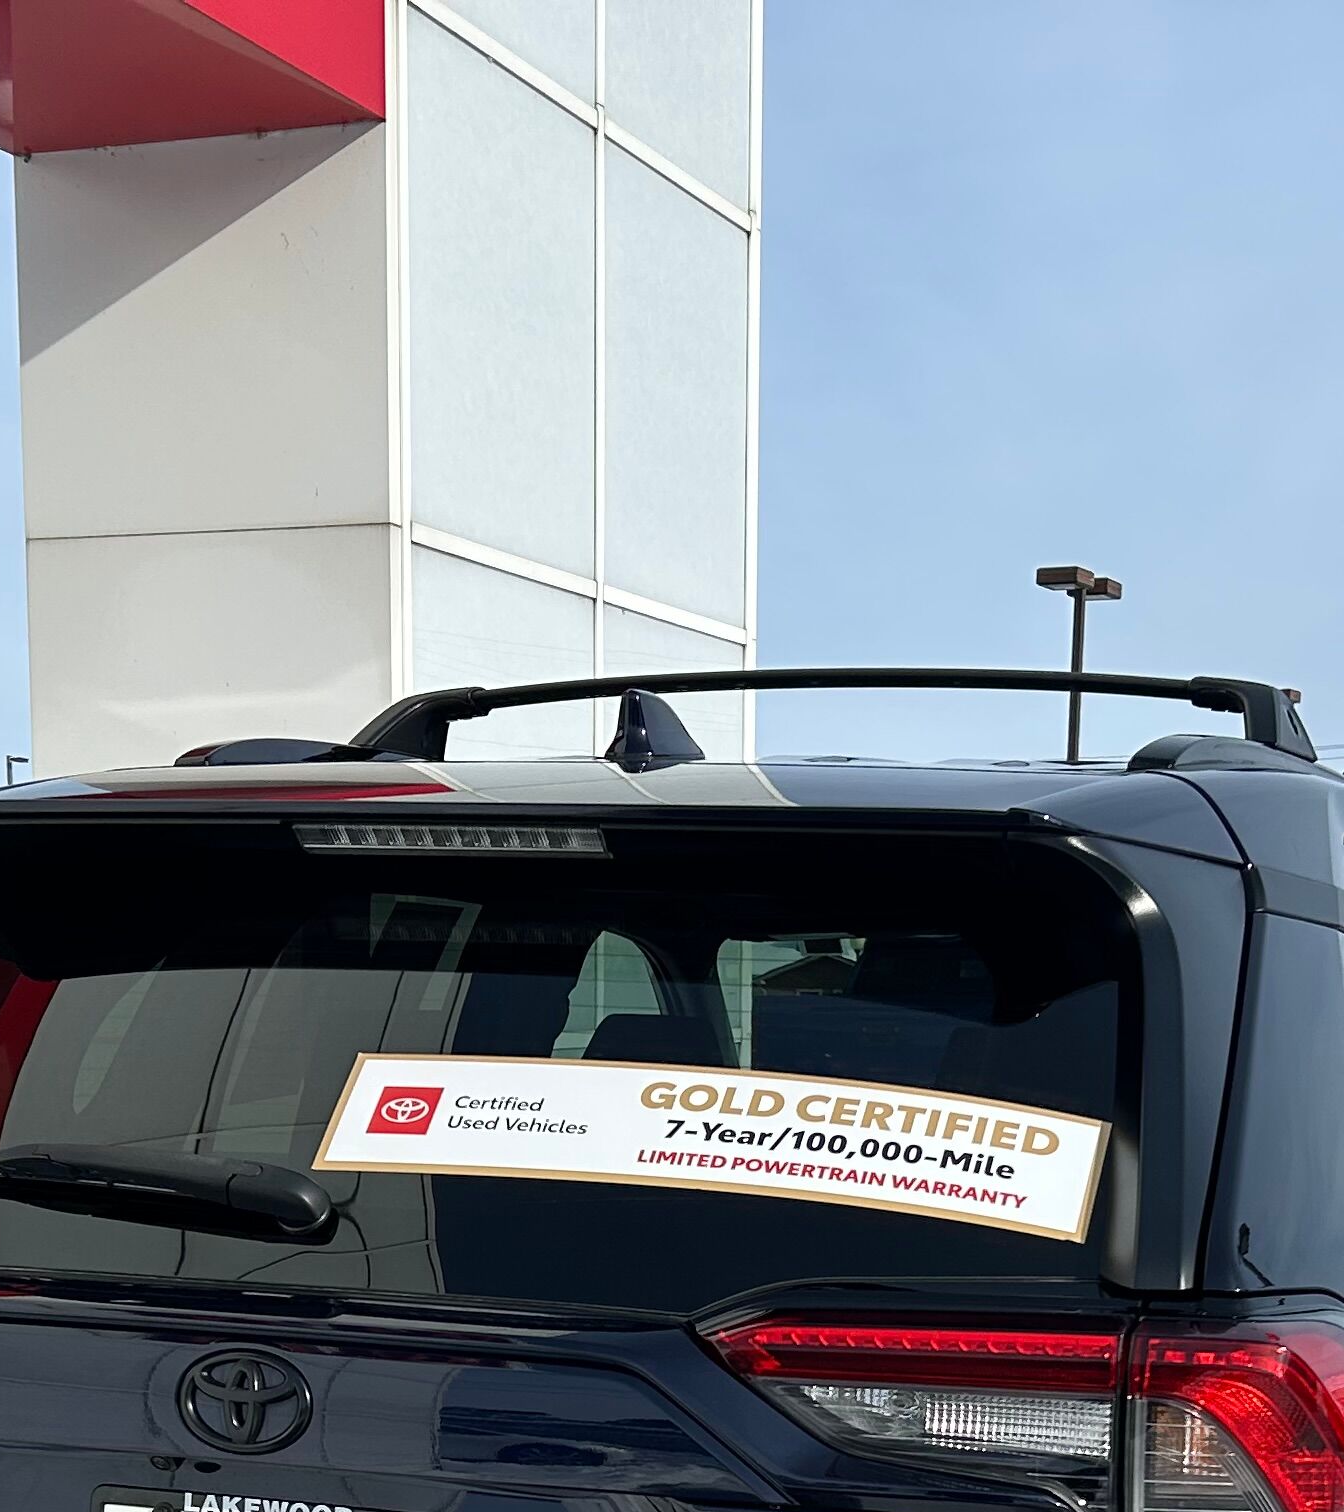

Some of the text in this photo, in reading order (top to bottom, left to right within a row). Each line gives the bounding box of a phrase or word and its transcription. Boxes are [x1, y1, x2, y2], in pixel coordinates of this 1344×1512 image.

[448, 1115, 588, 1134] Used Vehicles
[455, 1095, 545, 1112] Certified
[641, 1082, 1060, 1156] GOLD CERTIFIED
[637, 1149, 1028, 1208] LIMITED POWERTRAIN WARRANTY
[664, 1119, 1015, 1179] 7-Year/100,000-Mile
